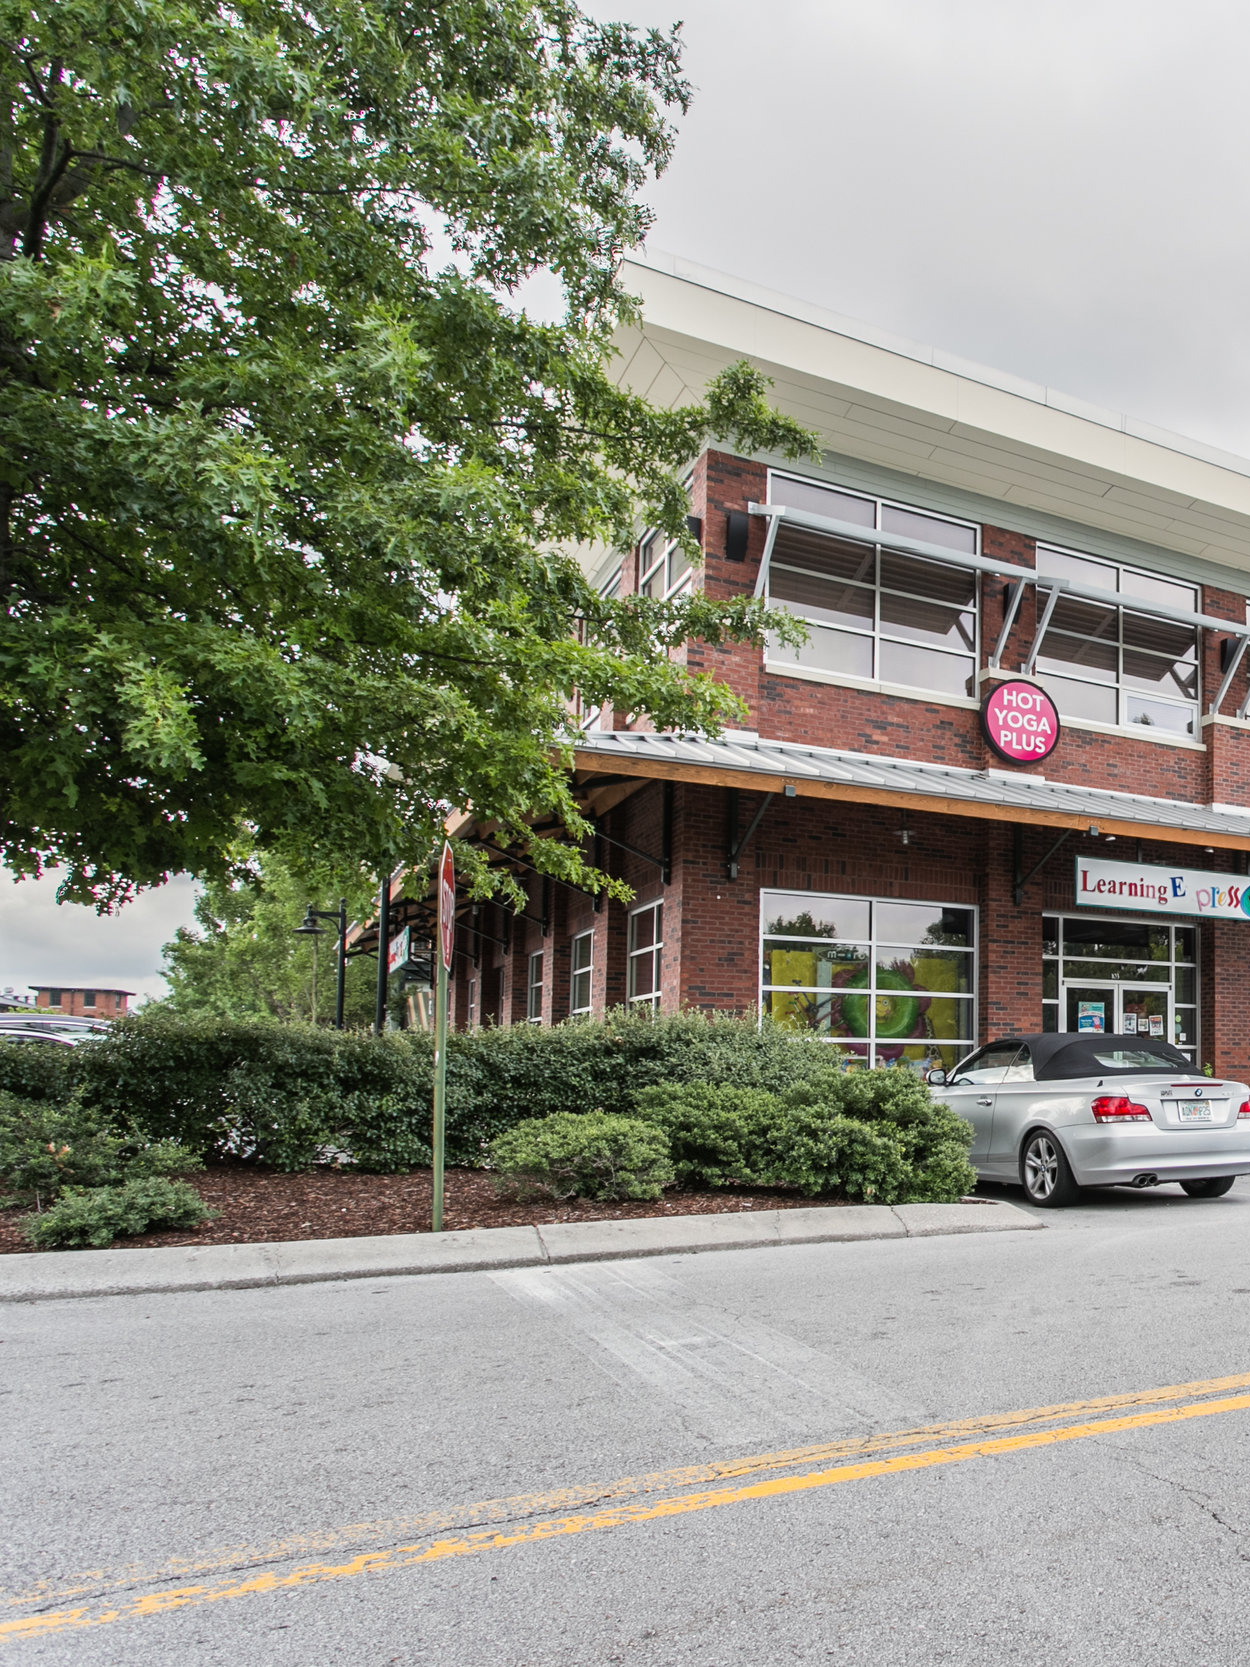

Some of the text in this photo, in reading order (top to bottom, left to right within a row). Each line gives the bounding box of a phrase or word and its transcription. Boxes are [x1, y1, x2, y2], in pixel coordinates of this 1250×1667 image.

[1003, 688, 1044, 712] HOT
[994, 707, 1051, 735] YOGA
[1000, 730, 1046, 754] PLUS
[1081, 869, 1168, 905] Learning
[1169, 876, 1241, 912] Epress
